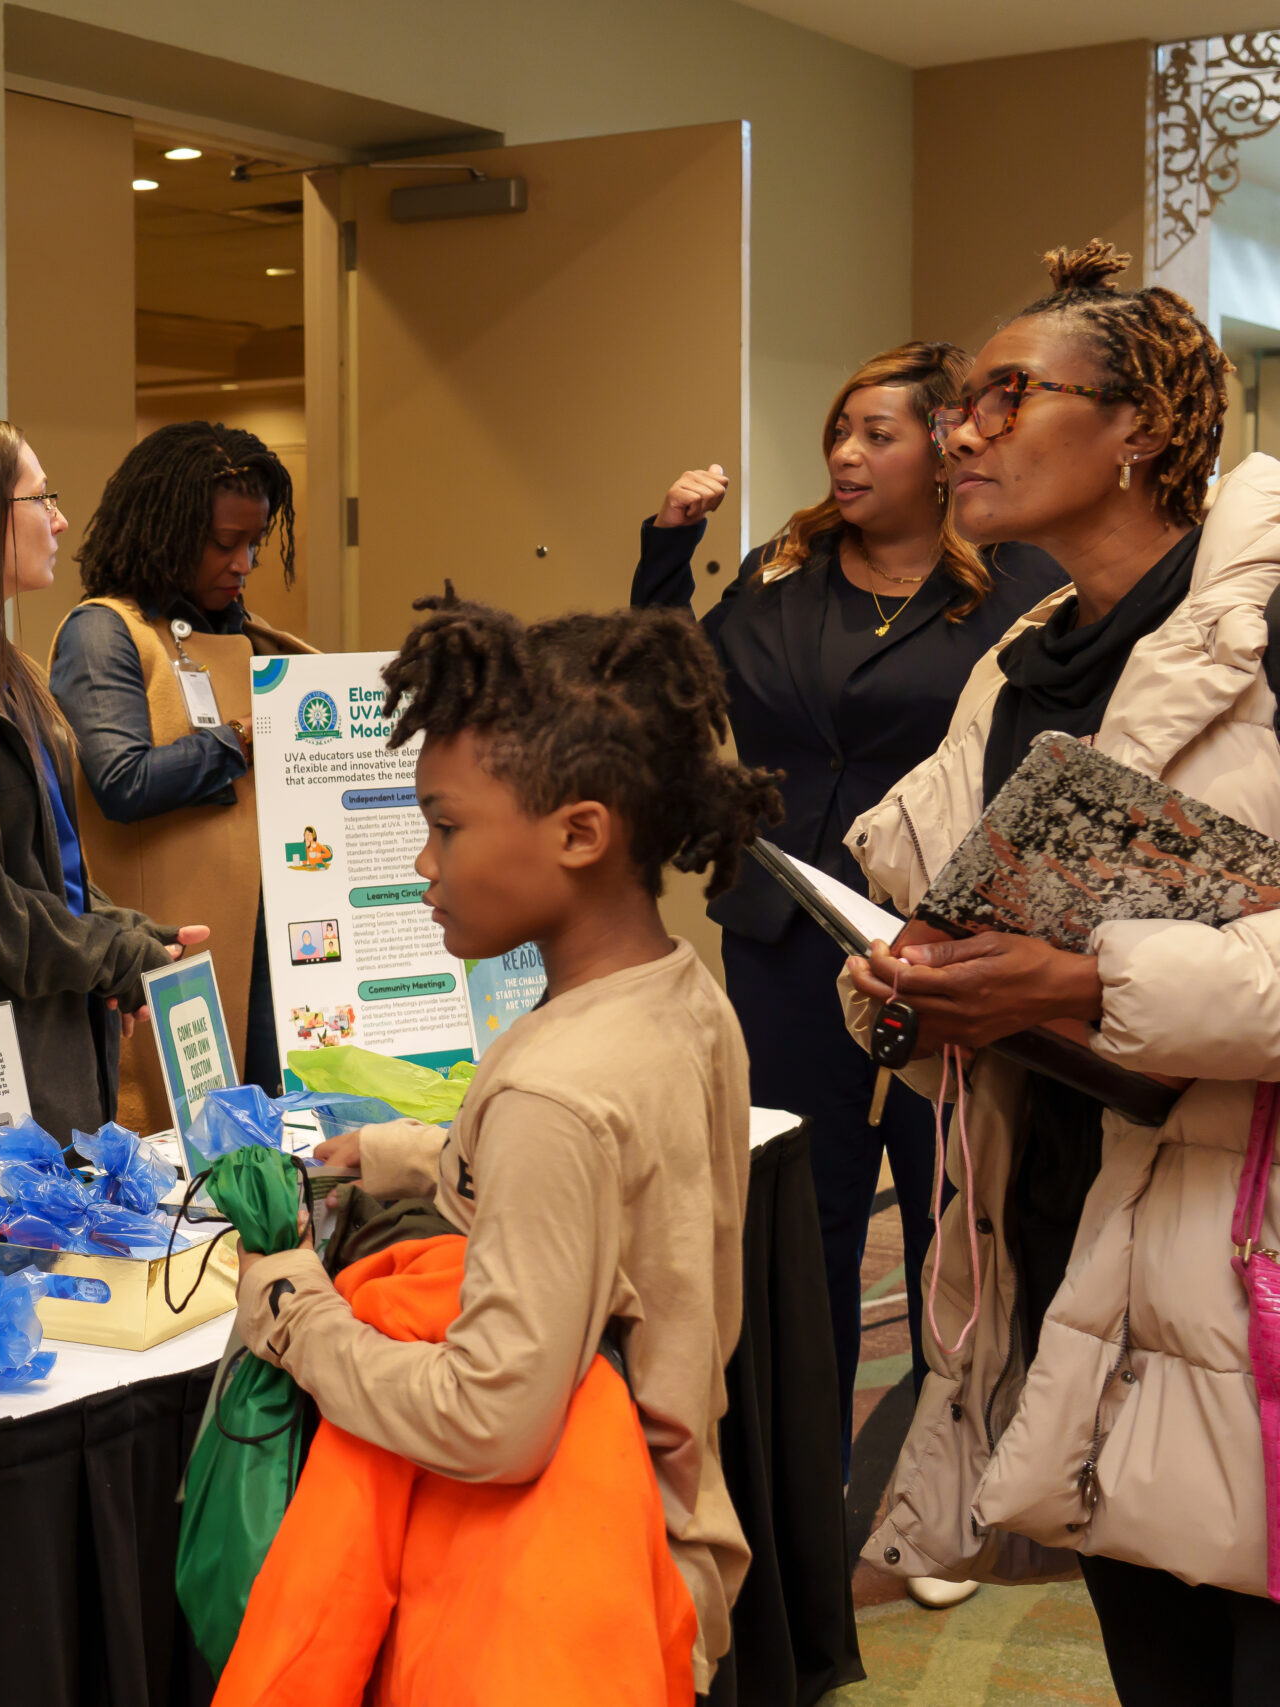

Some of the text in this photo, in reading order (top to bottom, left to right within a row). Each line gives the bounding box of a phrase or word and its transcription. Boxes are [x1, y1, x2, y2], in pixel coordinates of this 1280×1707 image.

[350, 705, 384, 720] UVA
[285, 753, 306, 762] UVA
[309, 751, 353, 761] educators
[357, 751, 372, 759] use
[375, 748, 399, 758] these
[294, 763, 327, 774] flexible
[331, 762, 347, 771] and
[350, 760, 396, 770] innovative
[286, 776, 305, 785] that
[308, 774, 375, 784] accommodates
[378, 771, 392, 780] the
[349, 795, 394, 804] Independent
[367, 891, 399, 900] Learning
[369, 980, 445, 993] Community Meetings
[504, 977, 517, 988] THE
[496, 989, 520, 1000] STARTS
[506, 999, 534, 1010] ARE YOU
[177, 1017, 208, 1042] COME MAKE
[183, 1038, 211, 1061] YOUR OWN
[190, 1058, 212, 1080] CUSTOM
